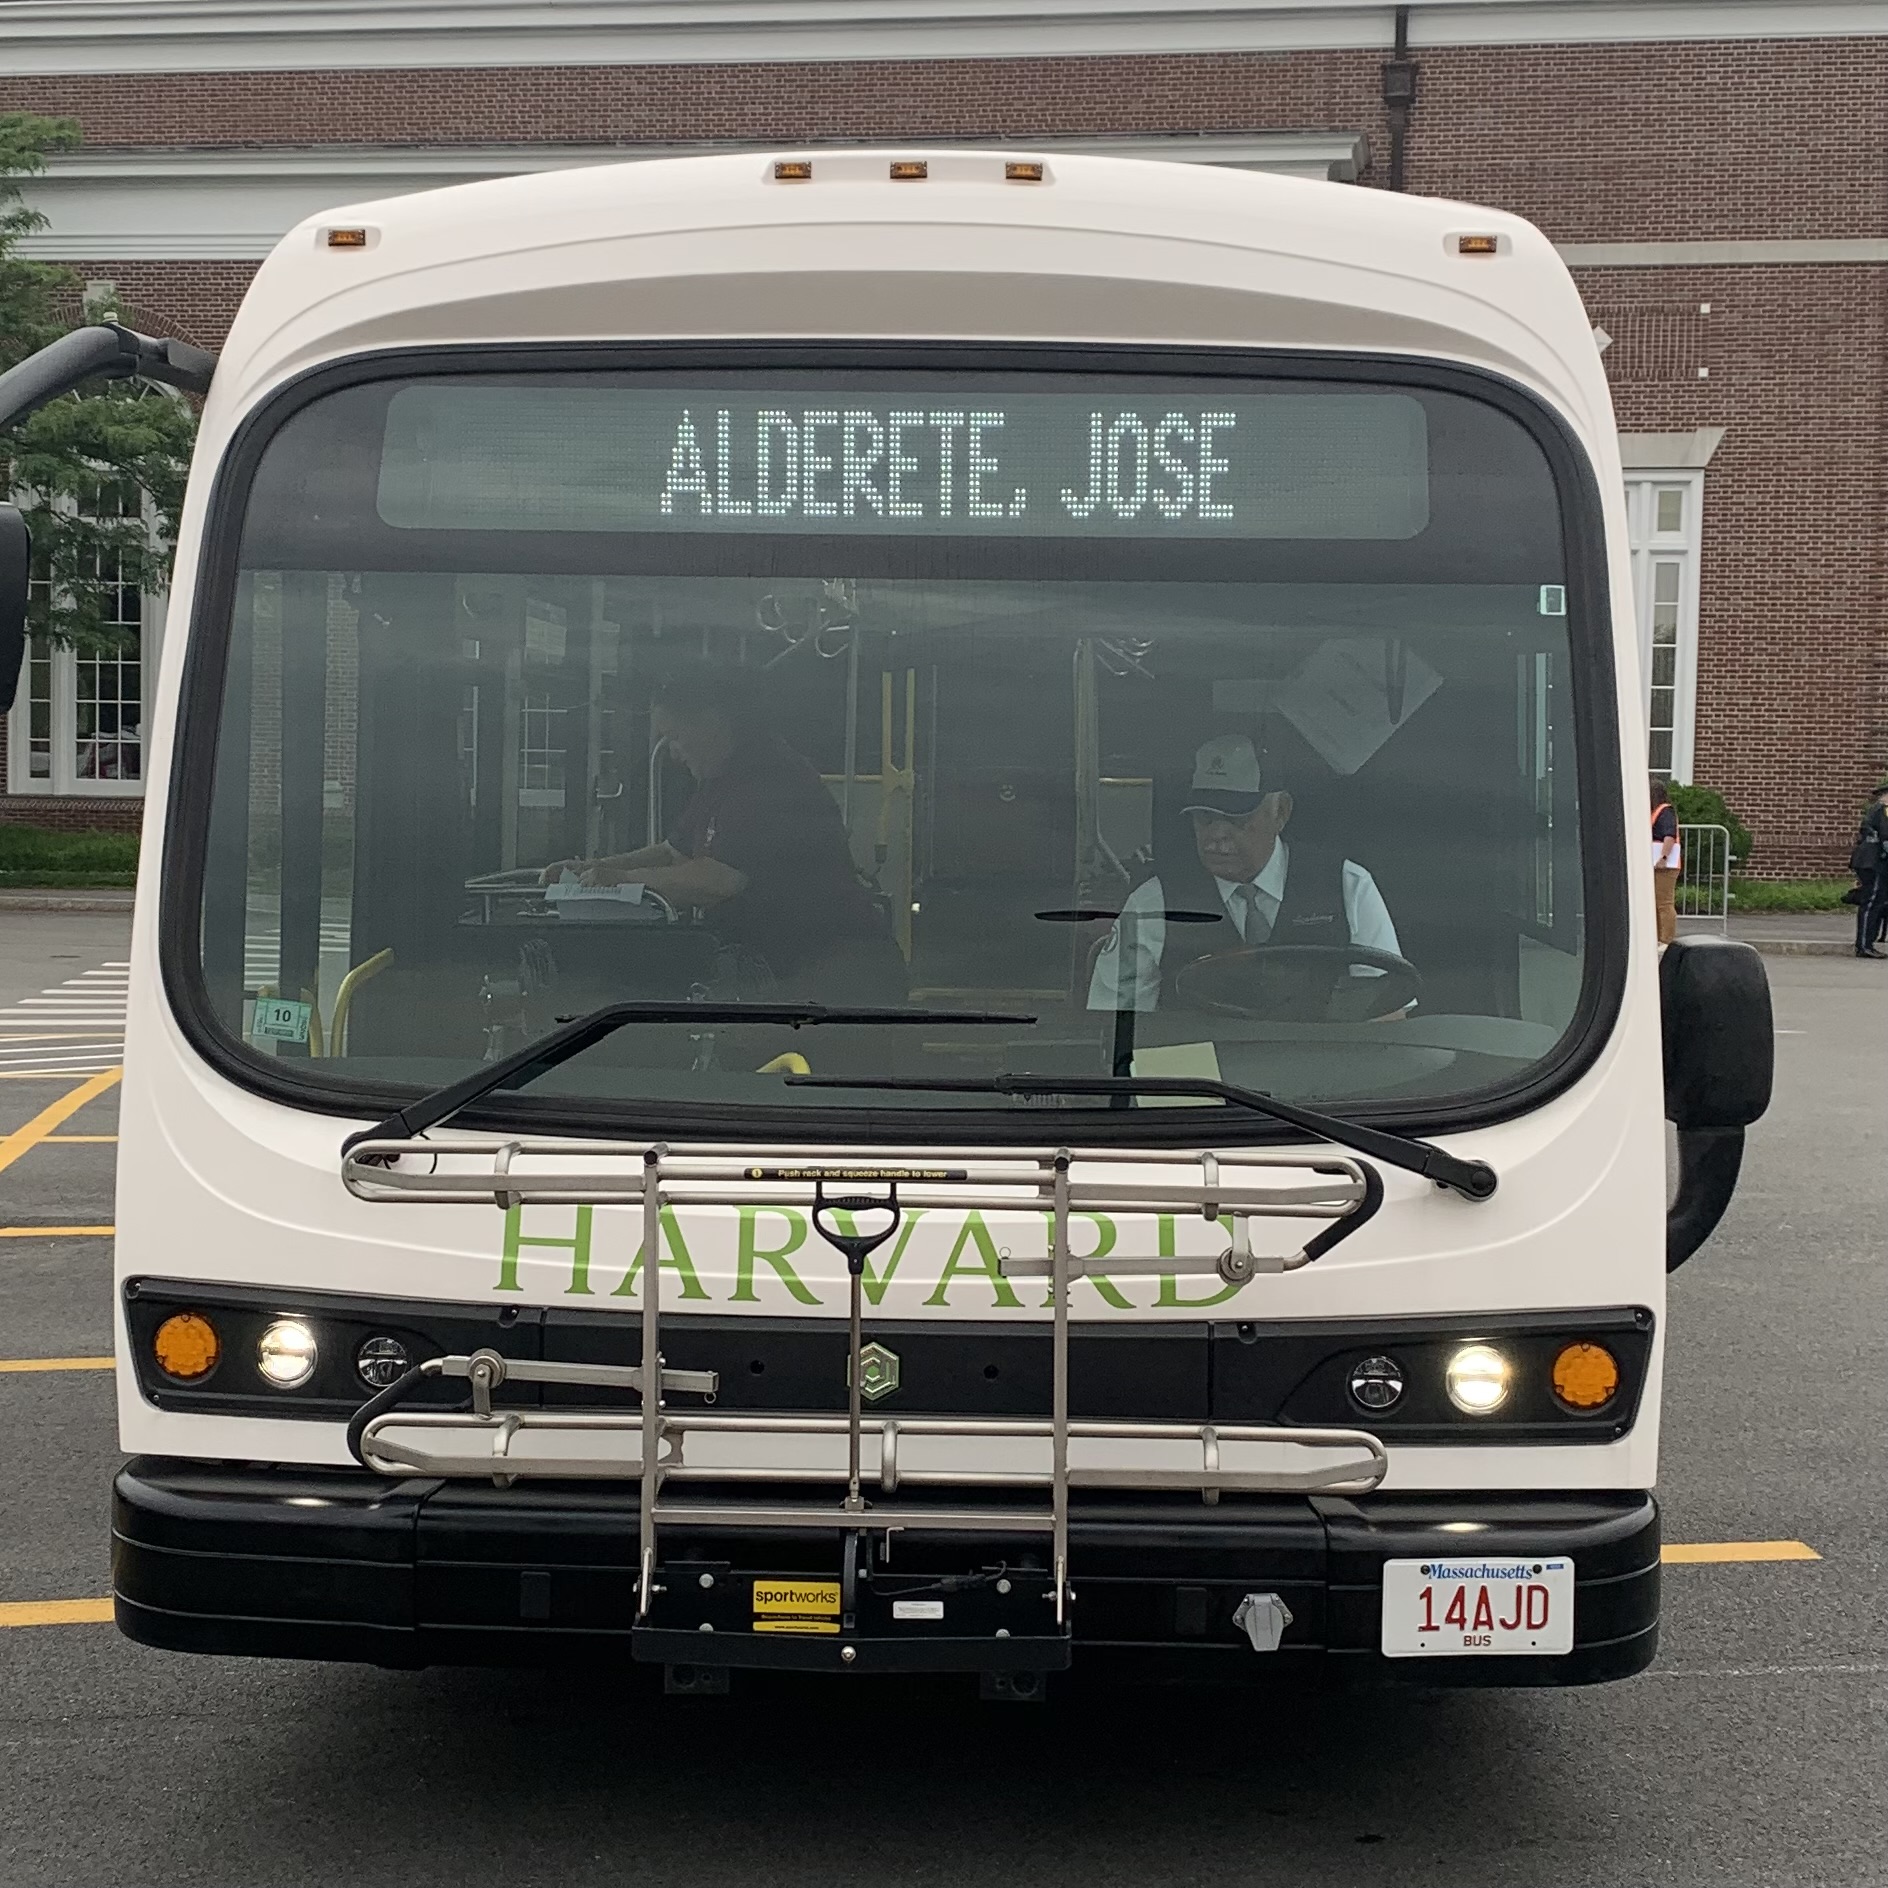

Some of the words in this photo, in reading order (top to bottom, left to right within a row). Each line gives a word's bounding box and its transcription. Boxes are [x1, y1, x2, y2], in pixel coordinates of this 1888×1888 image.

[660, 409, 1027, 517] ALDERETE,
[1060, 411, 1236, 519] JOSE
[274, 1008, 292, 1023] 10
[778, 1169, 801, 1179] Push
[803, 1169, 821, 1178] rack
[823, 1169, 841, 1178] and
[842, 1170, 879, 1180] squeeze
[880, 1169, 910, 1179] handle
[911, 1170, 921, 1178] to
[923, 1170, 948, 1178] lower
[492, 1201, 1253, 1311] HARVARD
[1428, 1563, 1533, 1580] Massachusetts
[756, 1589, 837, 1605] sportworks
[1418, 1584, 1550, 1632] 14AJD
[1463, 1635, 1492, 1647] BUS
